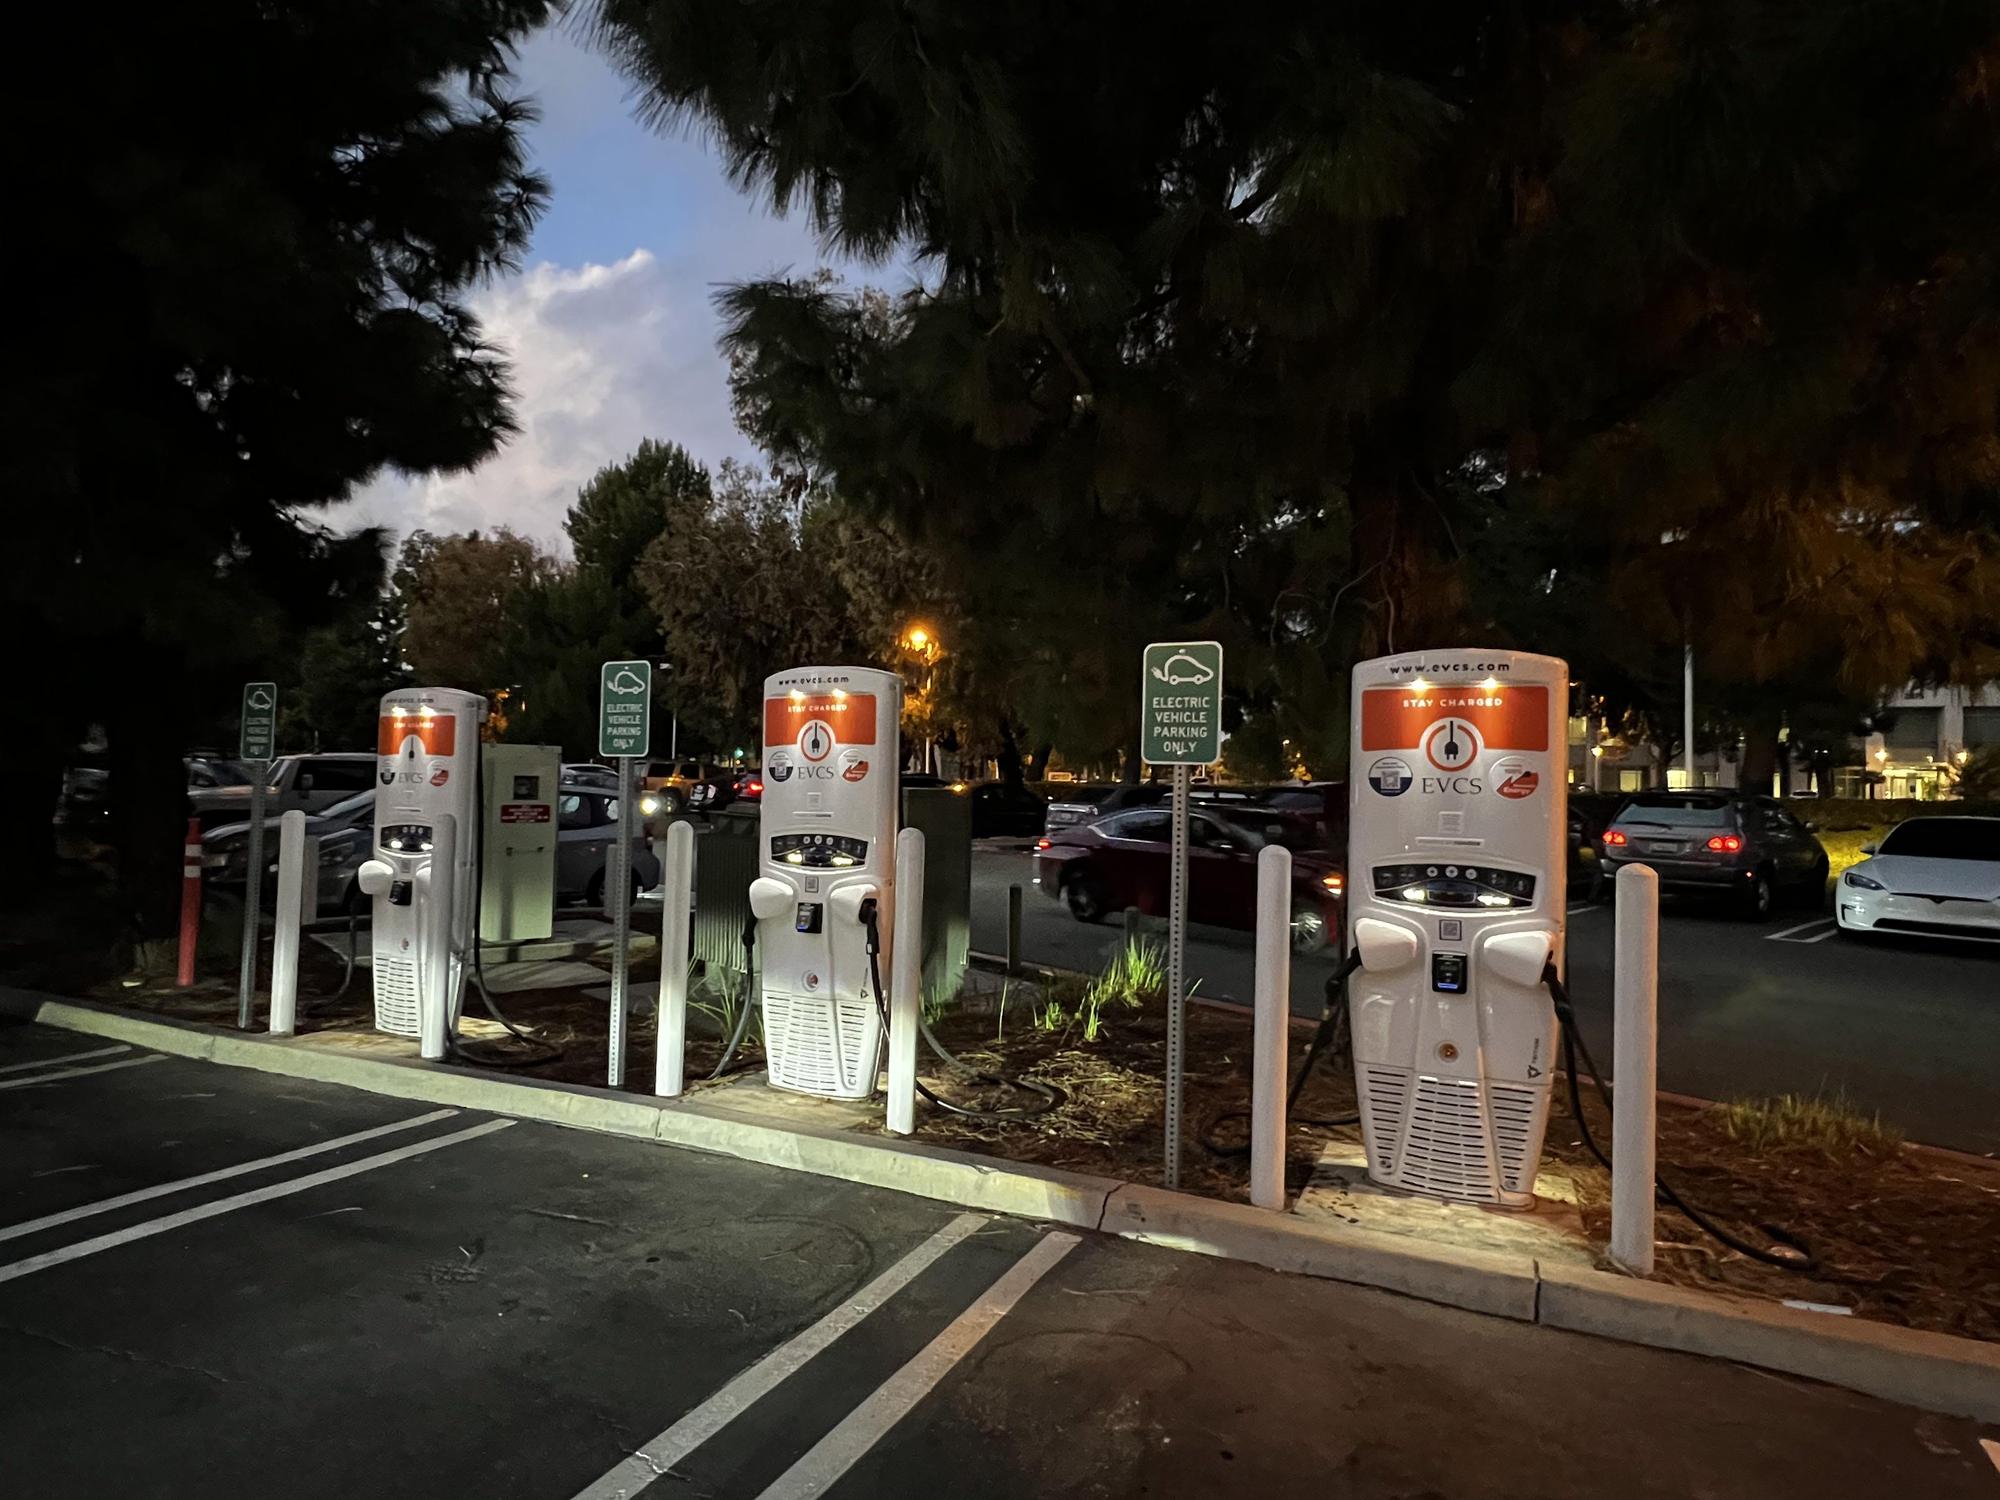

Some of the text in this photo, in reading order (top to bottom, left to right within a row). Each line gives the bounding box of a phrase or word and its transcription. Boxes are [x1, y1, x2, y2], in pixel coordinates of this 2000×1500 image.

[1390, 663, 1510, 674] www.evcs.com
[1152, 697, 1210, 708] ELECTRIC
[1403, 698, 1502, 708] STAY CHARGED
[606, 704, 643, 713] ELECTRIC
[608, 715, 641, 725] VEHICLE
[1155, 712, 1207, 723] VEHICLE
[606, 727, 642, 736] PARKING
[1153, 727, 1208, 738] PARKING
[1163, 741, 1197, 752] ONLY
[398, 772, 424, 784] EVCS
[798, 766, 834, 779] EVCS
[1421, 777, 1482, 795] EVCS
